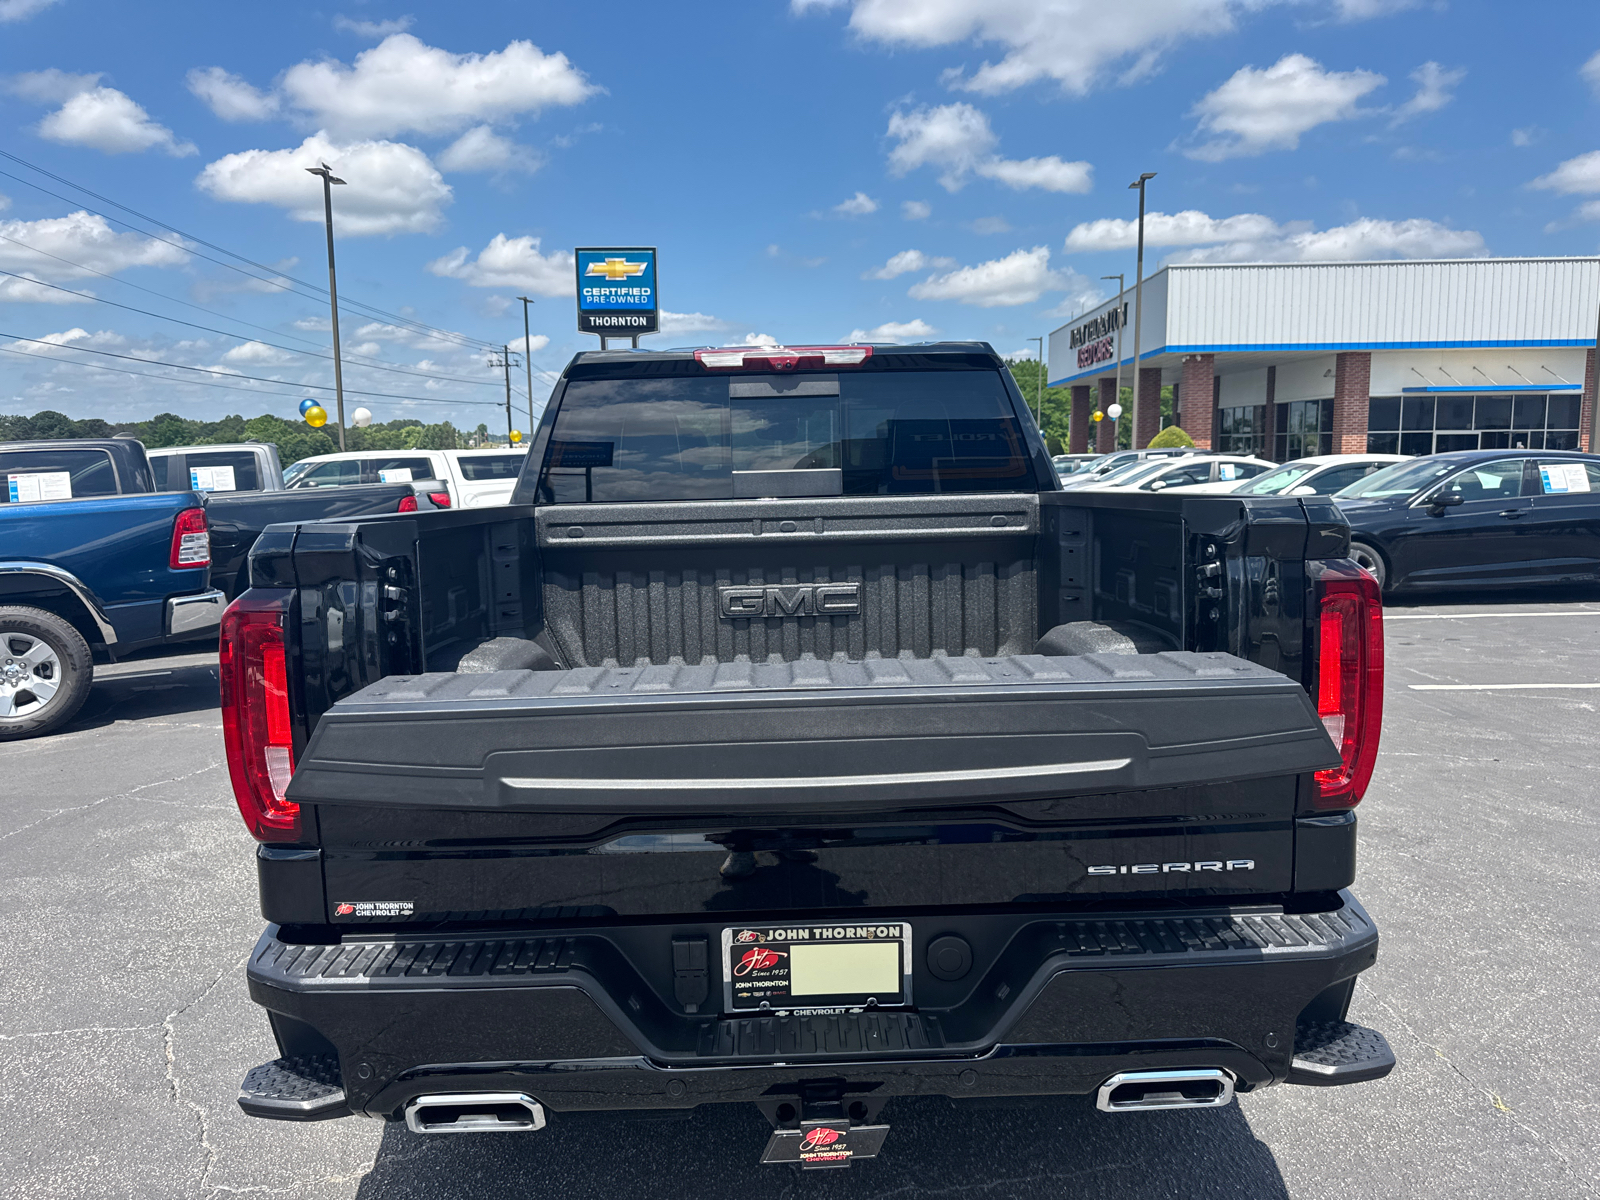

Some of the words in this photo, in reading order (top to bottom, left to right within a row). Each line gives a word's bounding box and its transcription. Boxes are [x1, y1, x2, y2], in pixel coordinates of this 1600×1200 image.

[583, 287, 651, 296] CERTIFIED
[586, 296, 648, 304] PRE-OWNED
[589, 316, 647, 326] THORNTON
[1093, 336, 1113, 362] CARS
[722, 586, 859, 615] GMC
[1087, 859, 1255, 876] SIERRA
[375, 902, 414, 910] THORNTON
[355, 909, 400, 917] CHEVROLET
[767, 928, 810, 941] JOHN
[813, 926, 900, 939] THORNTON
[771, 968, 788, 976] 1957
[735, 981, 752, 989] JOHN
[752, 980, 789, 988] THORNTON
[793, 1008, 846, 1016] CHEVROLET
